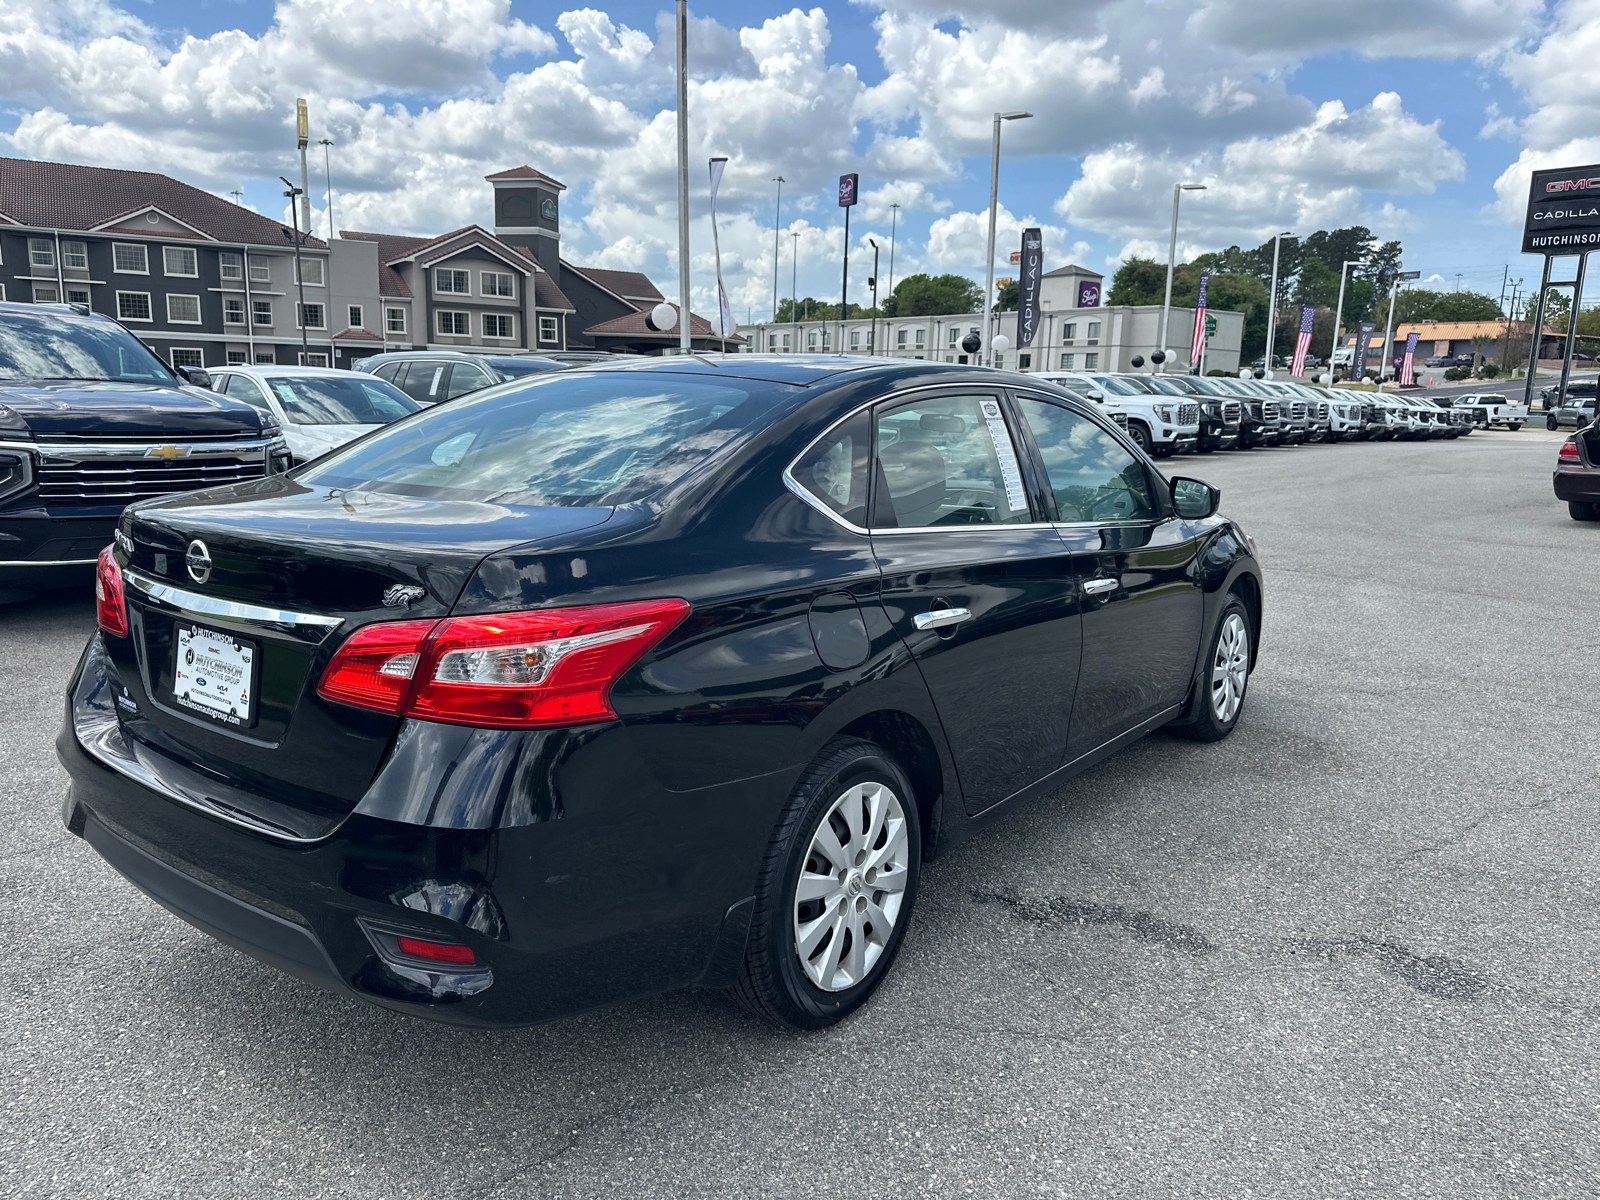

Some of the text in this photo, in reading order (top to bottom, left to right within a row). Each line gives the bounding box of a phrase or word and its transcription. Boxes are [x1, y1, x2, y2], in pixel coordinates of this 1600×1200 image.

[1533, 208, 1599, 220] CADILLA
[1023, 255, 1038, 342] CADILLAC
[1356, 333, 1368, 378] CADILLAC
[197, 627, 234, 645] HUTCHINSON
[195, 653, 243, 678] HUTCHINSON
[195, 666, 240, 686] AUTOMOTIVE GROUP
